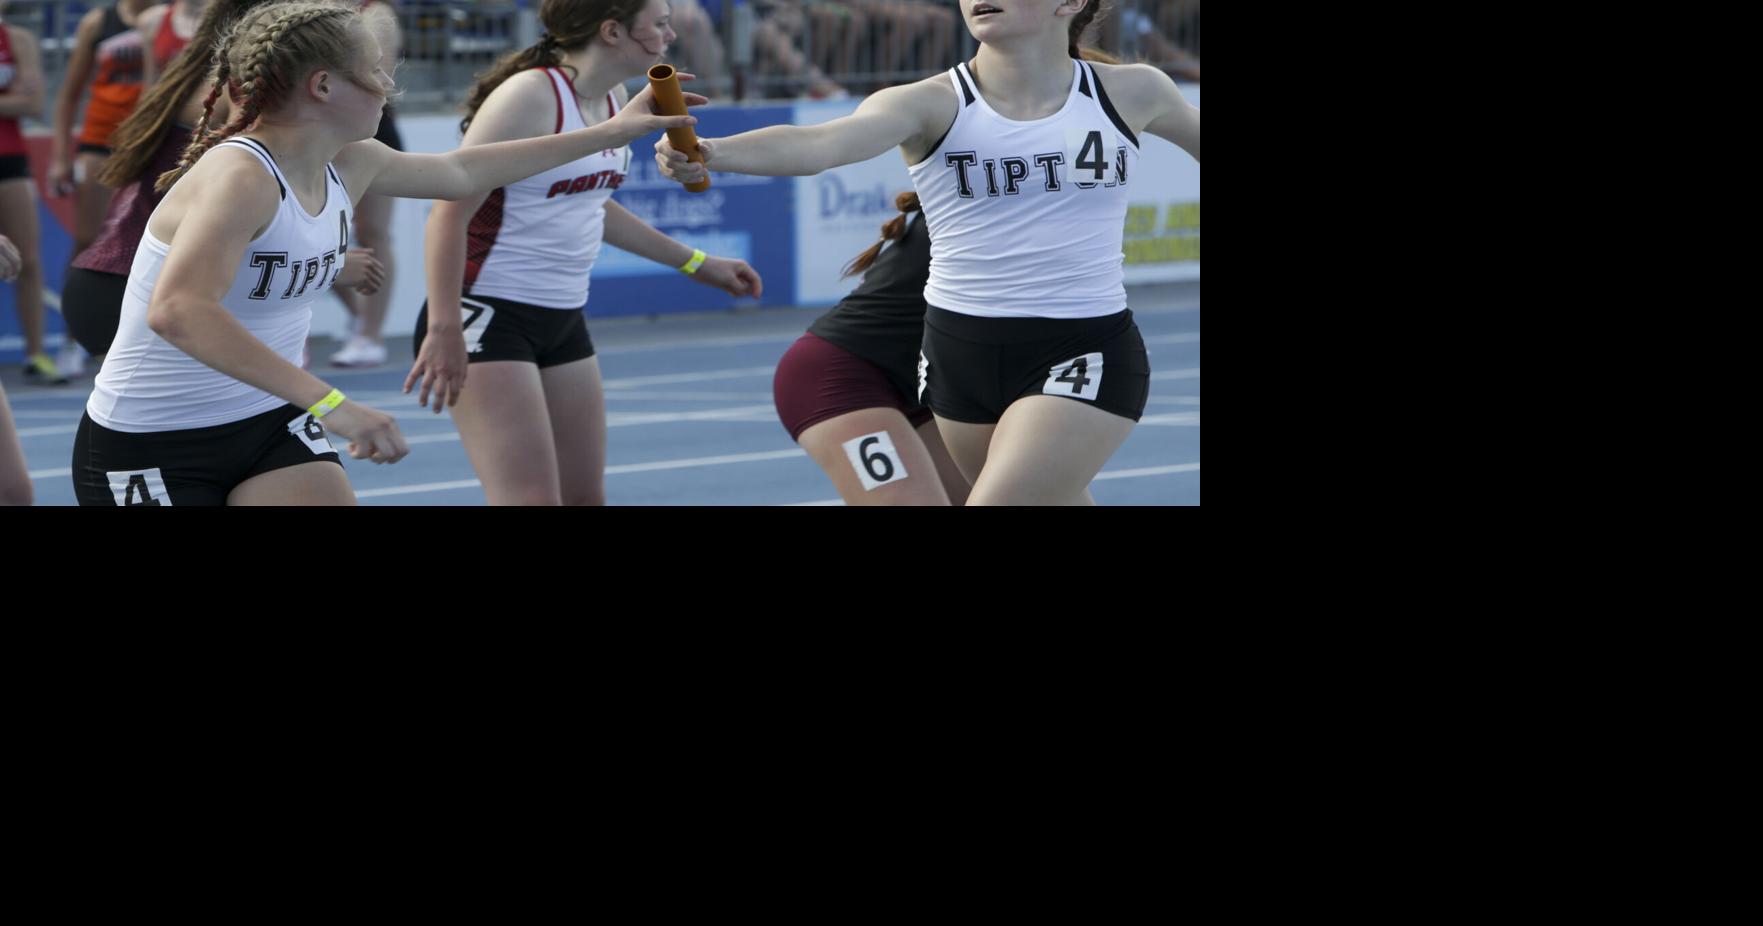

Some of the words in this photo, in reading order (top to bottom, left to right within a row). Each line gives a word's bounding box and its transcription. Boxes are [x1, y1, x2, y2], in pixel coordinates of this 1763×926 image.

[945, 146, 1128, 199] TIPTN
[1075, 130, 1109, 180] 4
[1055, 357, 1091, 394] 4
[859, 436, 894, 482] 6
[124, 474, 161, 506] 4
